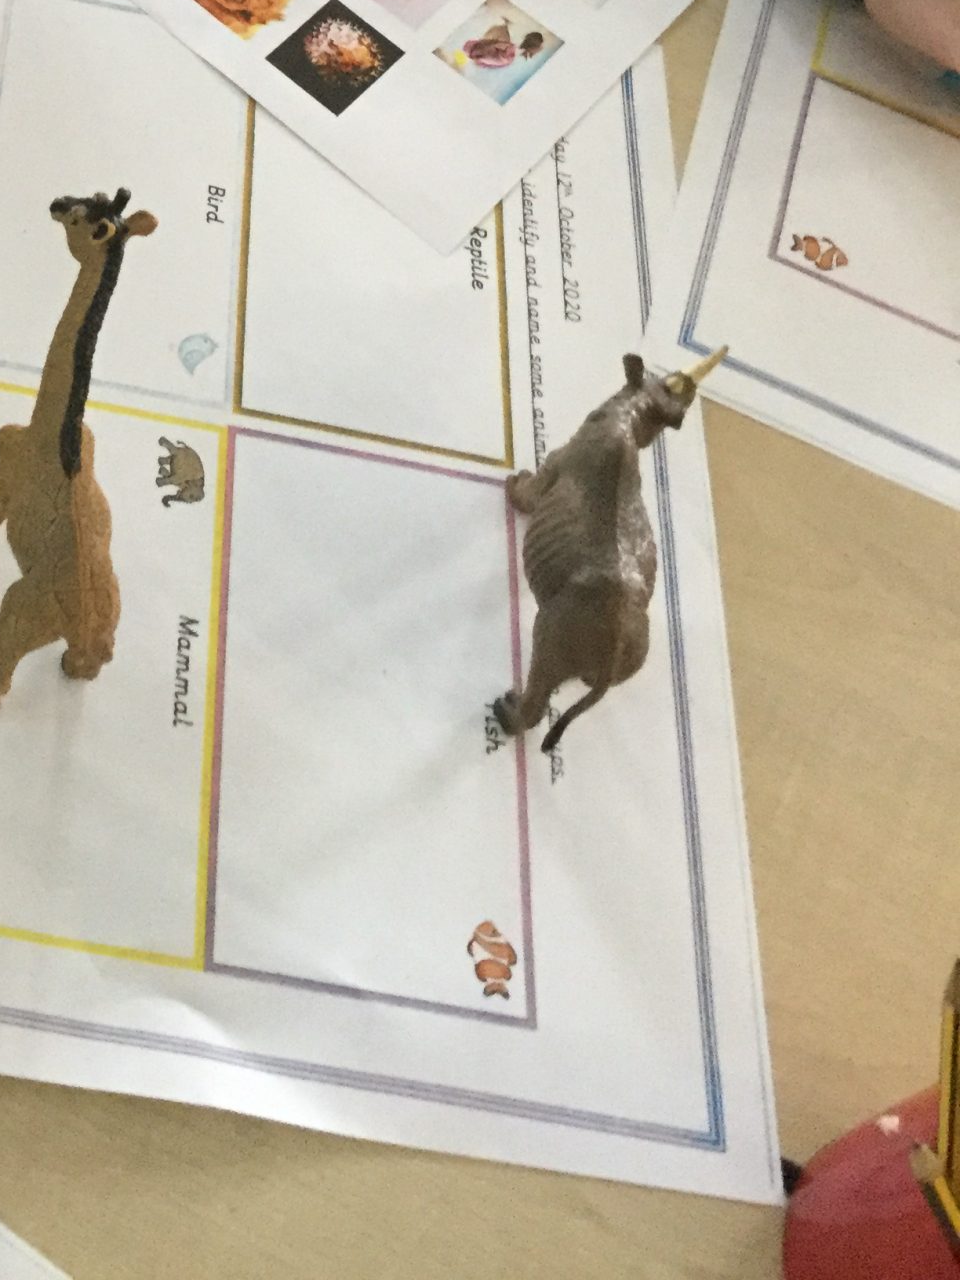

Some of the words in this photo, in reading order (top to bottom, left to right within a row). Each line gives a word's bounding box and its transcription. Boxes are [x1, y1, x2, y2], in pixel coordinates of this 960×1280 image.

[206, 185, 226, 224] Bird
[519, 182, 540, 248] identify
[464, 225, 490, 291] Reptile
[559, 206, 576, 268] October
[525, 256, 542, 288] and
[527, 297, 541, 345] name
[564, 276, 582, 322] 2020
[531, 354, 544, 400] some
[172, 614, 199, 728] Mammal
